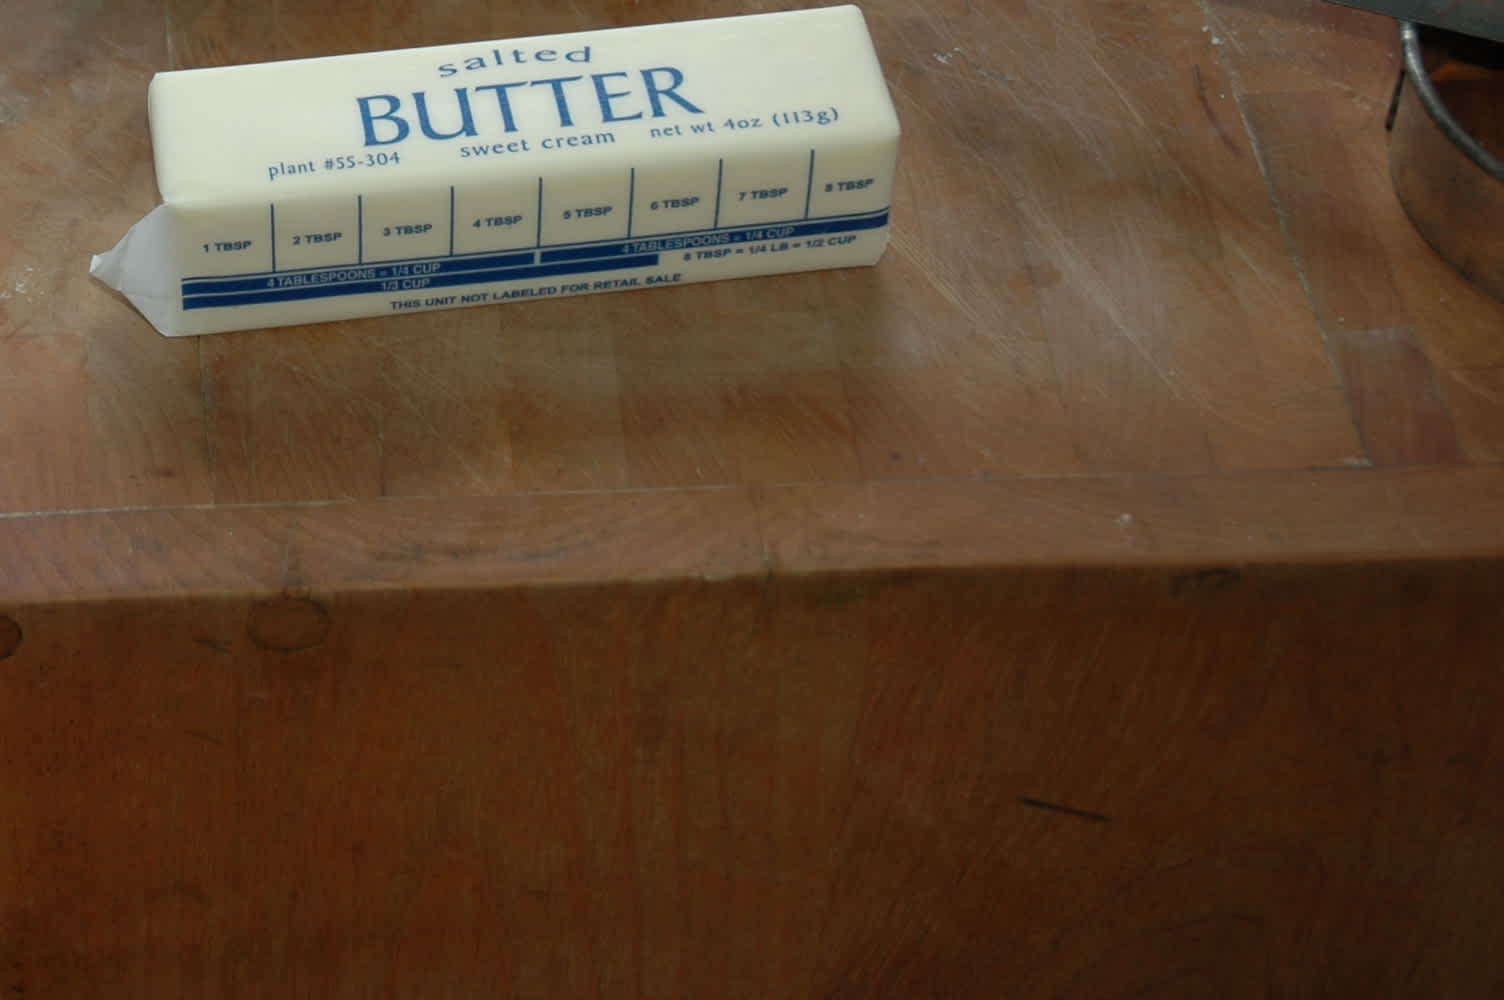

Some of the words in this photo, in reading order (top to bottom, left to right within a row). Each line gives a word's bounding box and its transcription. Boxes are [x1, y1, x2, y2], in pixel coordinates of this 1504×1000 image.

[437, 46, 592, 78] salted
[356, 66, 705, 148] BUTTER
[650, 124, 683, 139] net
[690, 121, 715, 135] wt
[723, 117, 763, 130] 4oz
[771, 107, 840, 127] (113g)
[460, 138, 530, 158] sweet
[541, 132, 616, 150] cream
[268, 162, 316, 181] plant
[325, 151, 401, 171] #55-304
[738, 191, 747, 201] 7
[751, 187, 789, 200] TBSP
[824, 183, 833, 193] 8
[837, 178, 875, 192] TBSP
[563, 210, 571, 220] 5
[575, 206, 613, 219] TBSP
[650, 201, 659, 210] 6
[662, 196, 700, 209] TBSP
[383, 227, 391, 237] 3
[396, 223, 433, 236] TBSP
[472, 218, 481, 228] 4
[485, 214, 523, 227] TBSP
[214, 240, 252, 252] TBSP
[292, 235, 301, 246] 2
[305, 231, 342, 244] TBSP
[633, 232, 731, 253] TABLESPOONS
[746, 228, 764, 240] 1/4
[766, 226, 795, 239] CUP
[696, 248, 733, 261] TBSP
[748, 245, 767, 256] 1/4
[770, 242, 789, 253] LB
[806, 239, 824, 249] 1/2
[827, 235, 857, 247] CUP
[266, 278, 274, 289] 4
[277, 268, 377, 288] TABLESPOONS
[391, 265, 410, 277] 1/4
[412, 262, 441, 275] CUP
[401, 278, 431, 290] CUP
[390, 298, 422, 310] THIS
[424, 295, 456, 307] UNIT
[460, 292, 490, 304] NOT
[492, 286, 557, 301] LABELED
[560, 282, 590, 294] FOR
[593, 276, 641, 290] RETAIL
[644, 273, 683, 285] SALE
